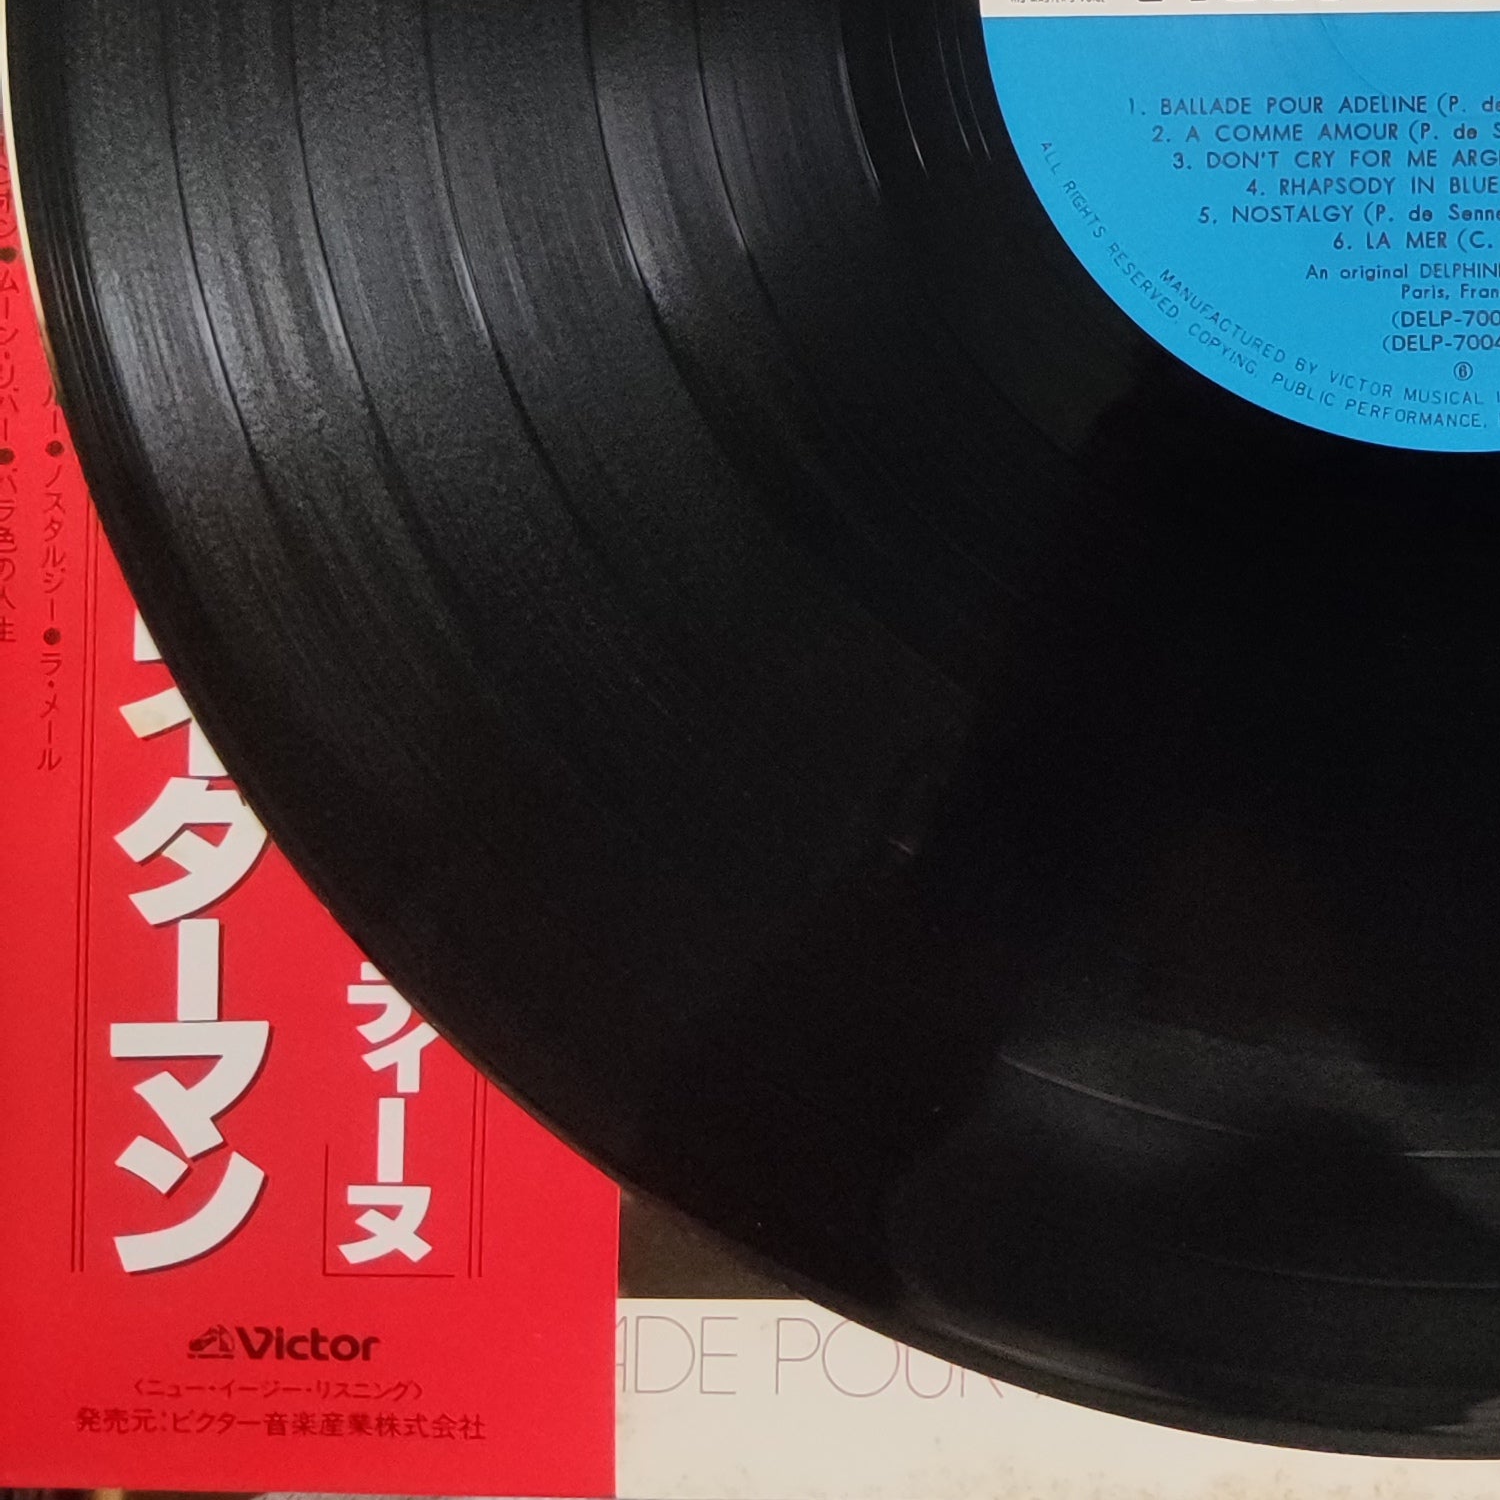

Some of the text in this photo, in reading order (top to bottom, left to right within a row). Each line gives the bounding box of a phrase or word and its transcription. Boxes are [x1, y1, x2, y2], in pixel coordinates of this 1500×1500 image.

[1128, 97, 1147, 116] 1.
[1160, 97, 1252, 116] BALLADE
[1267, 96, 1324, 115] POUR
[1338, 95, 1428, 115] ADELINE
[1437, 92, 1467, 118] (P.
[1152, 124, 1172, 143] 2.
[1185, 125, 1201, 143] A
[1215, 124, 1304, 143] COMME
[1317, 122, 1399, 142] AMOUR
[1408, 119, 1438, 145] (P.
[1453, 121, 1478, 141] de
[1172, 152, 1193, 170] 3.
[1206, 151, 1280, 169] DON'T
[1294, 150, 1337, 169] CRY
[1350, 149, 1392, 168] FOR
[1407, 149, 1438, 168] ME
[1246, 177, 1266, 197] 4.
[1280, 176, 1397, 197] RHAPSODY
[1411, 176, 1436, 195] IN
[1449, 176, 1500, 195] BLUE
[1198, 206, 1218, 226] 5.
[1232, 204, 1354, 224] NOSTALGY
[1364, 201, 1395, 226] (P.
[1408, 204, 1434, 222] de
[1333, 231, 1353, 251] 6.
[1366, 231, 1392, 250] LA
[1406, 231, 1448, 250] MER
[1457, 228, 1494, 253] (C.
[1041, 141, 1064, 177] ALL
[1063, 180, 1107, 239] RIGHTS
[1271, 371, 1336, 407] PUBLIC
[1305, 264, 1329, 280] An
[1340, 263, 1409, 282] original
[1401, 283, 1451, 301] Paris,
[1159, 268, 1286, 364] MANUFACTURED
[1294, 357, 1319, 376] BY
[1329, 369, 1393, 399] VICTOR
[1403, 387, 1484, 406] MUSICAL
[235, 1325, 382, 1361] Victor
